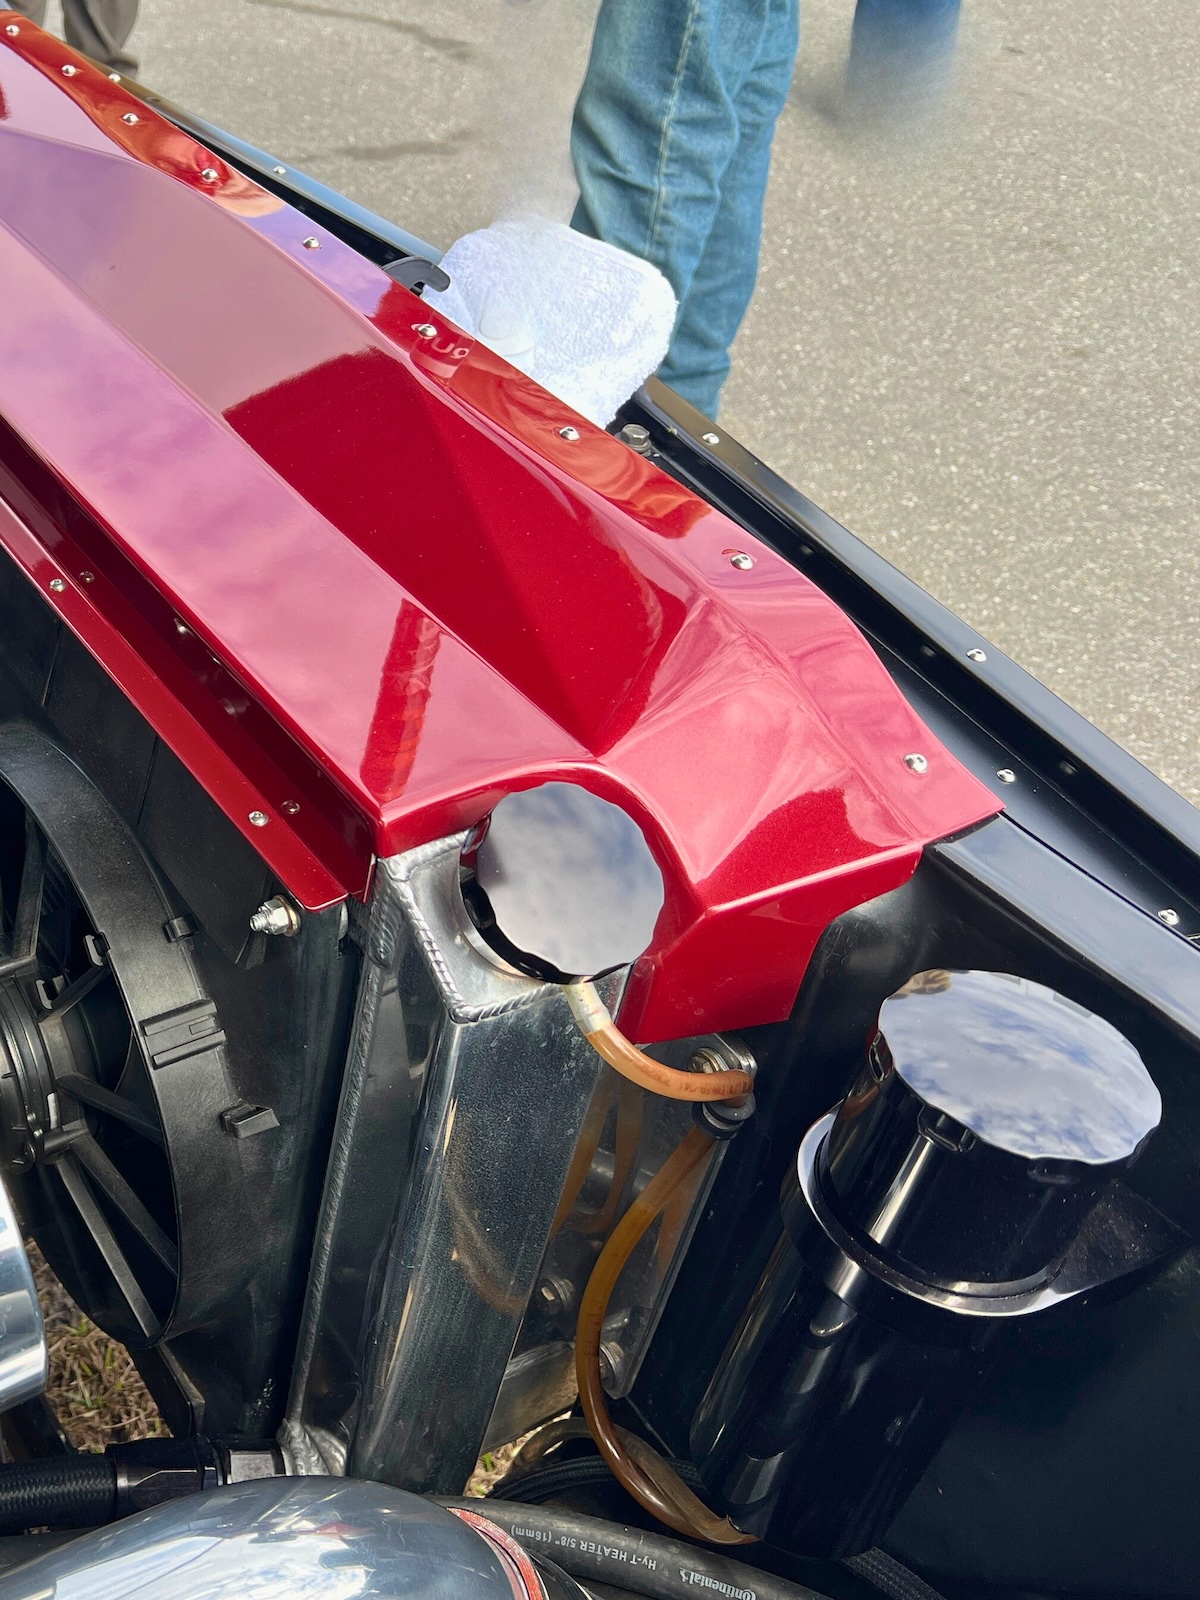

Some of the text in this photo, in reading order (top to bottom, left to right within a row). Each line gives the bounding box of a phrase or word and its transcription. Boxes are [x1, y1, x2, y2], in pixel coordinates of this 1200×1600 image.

[510, 1524, 657, 1571] Hy-T HEATER 5/8" (16mm)
